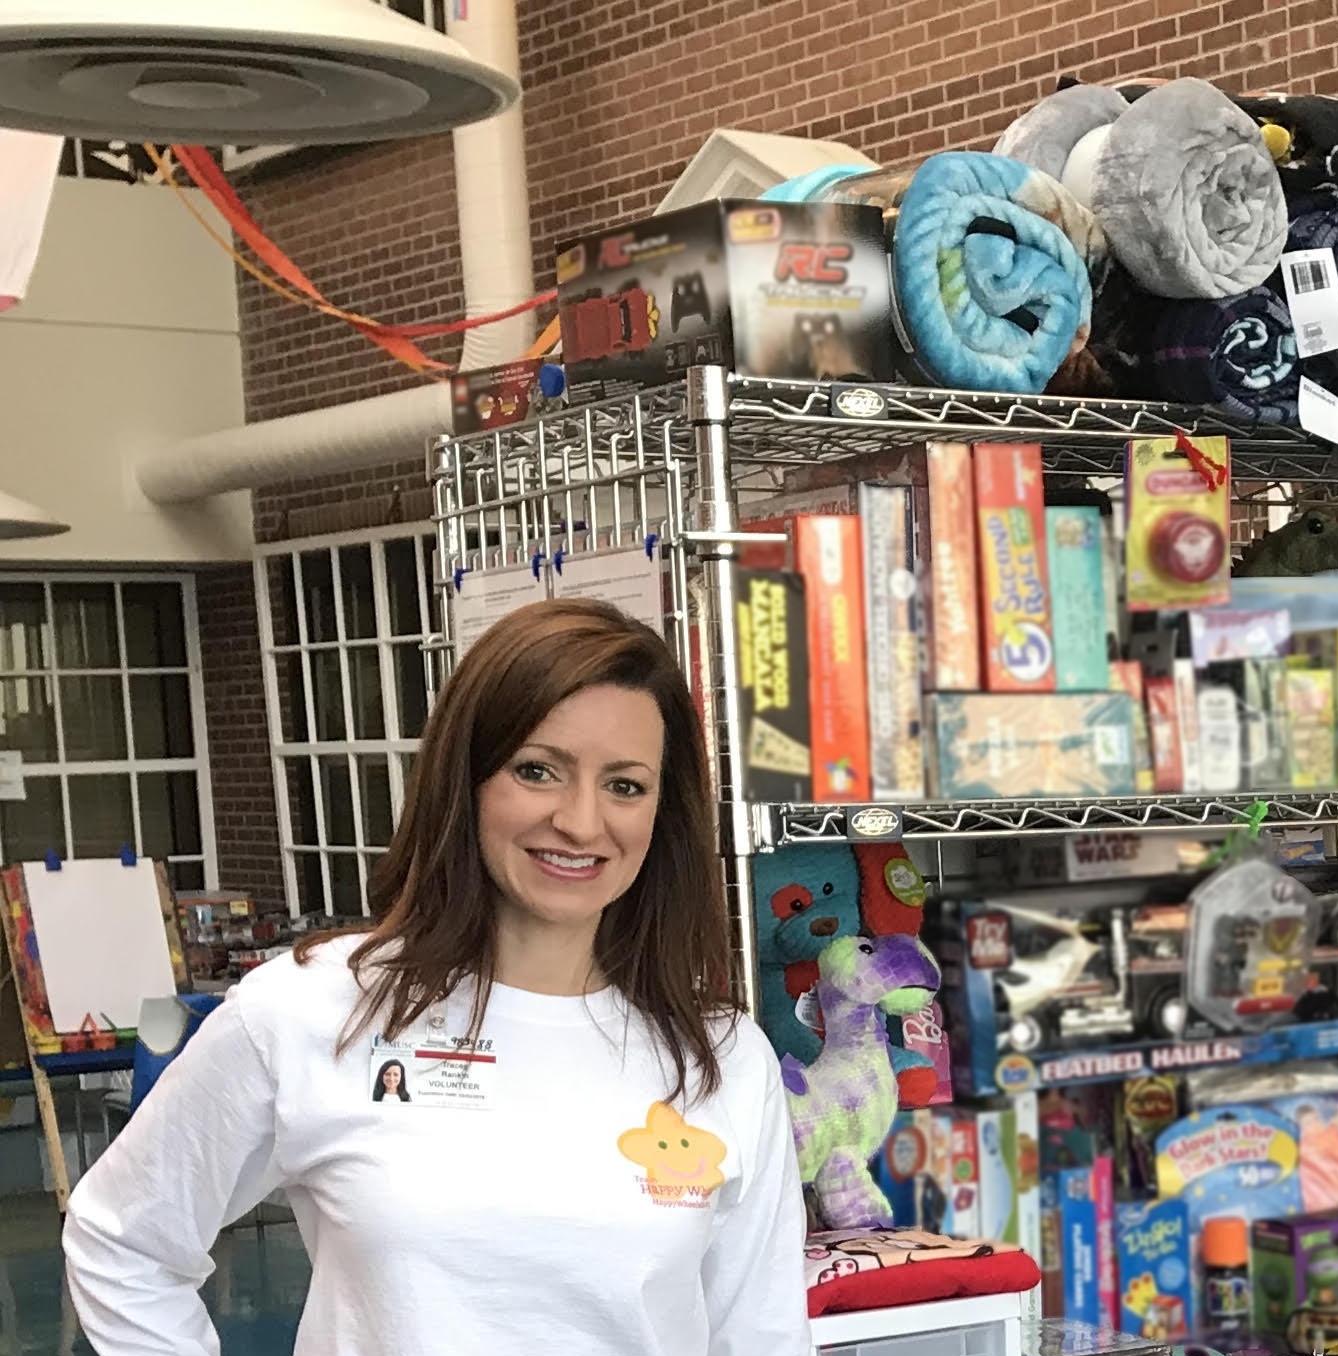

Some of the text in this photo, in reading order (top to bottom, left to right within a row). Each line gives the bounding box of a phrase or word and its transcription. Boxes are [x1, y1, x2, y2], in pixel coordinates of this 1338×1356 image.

[777, 243, 850, 283] RC
[1075, 844, 1140, 864] WARS
[972, 918, 1009, 940] Try
[1041, 1042, 1242, 1082] FLATBED HAULER
[429, 1080, 480, 1090] VOLUNTEER
[1168, 1120, 1273, 1161] Glow in the
